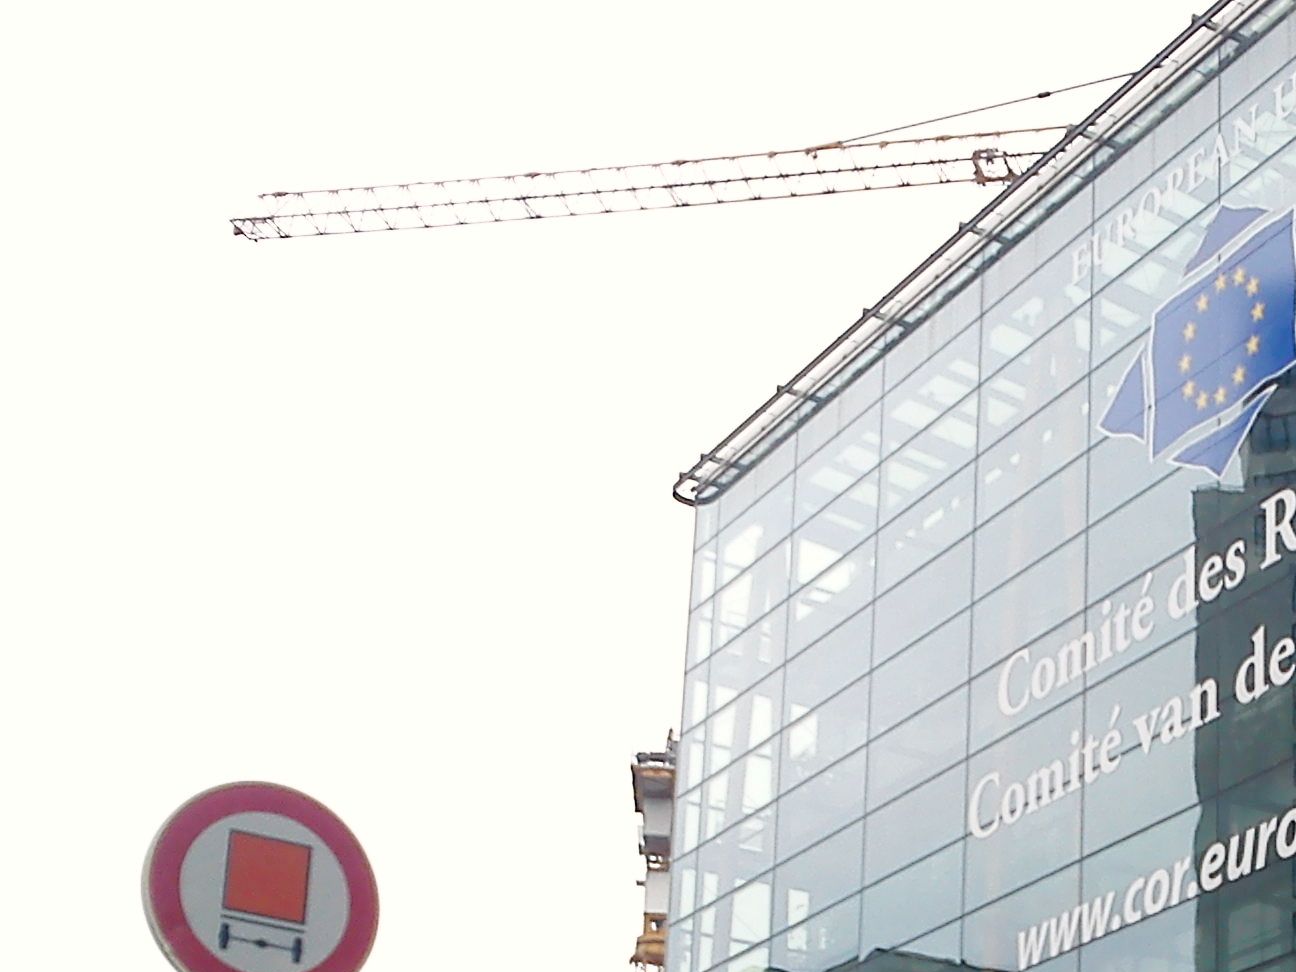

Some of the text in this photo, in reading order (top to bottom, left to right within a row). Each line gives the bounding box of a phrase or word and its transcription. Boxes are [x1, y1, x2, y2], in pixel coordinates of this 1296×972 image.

[1071, 103, 1259, 284] EUROPEAN
[998, 571, 1155, 717] Comité
[1167, 537, 1247, 619] des
[968, 704, 1123, 840] Comité
[1132, 678, 1221, 755] van
[1234, 626, 1295, 704] de
